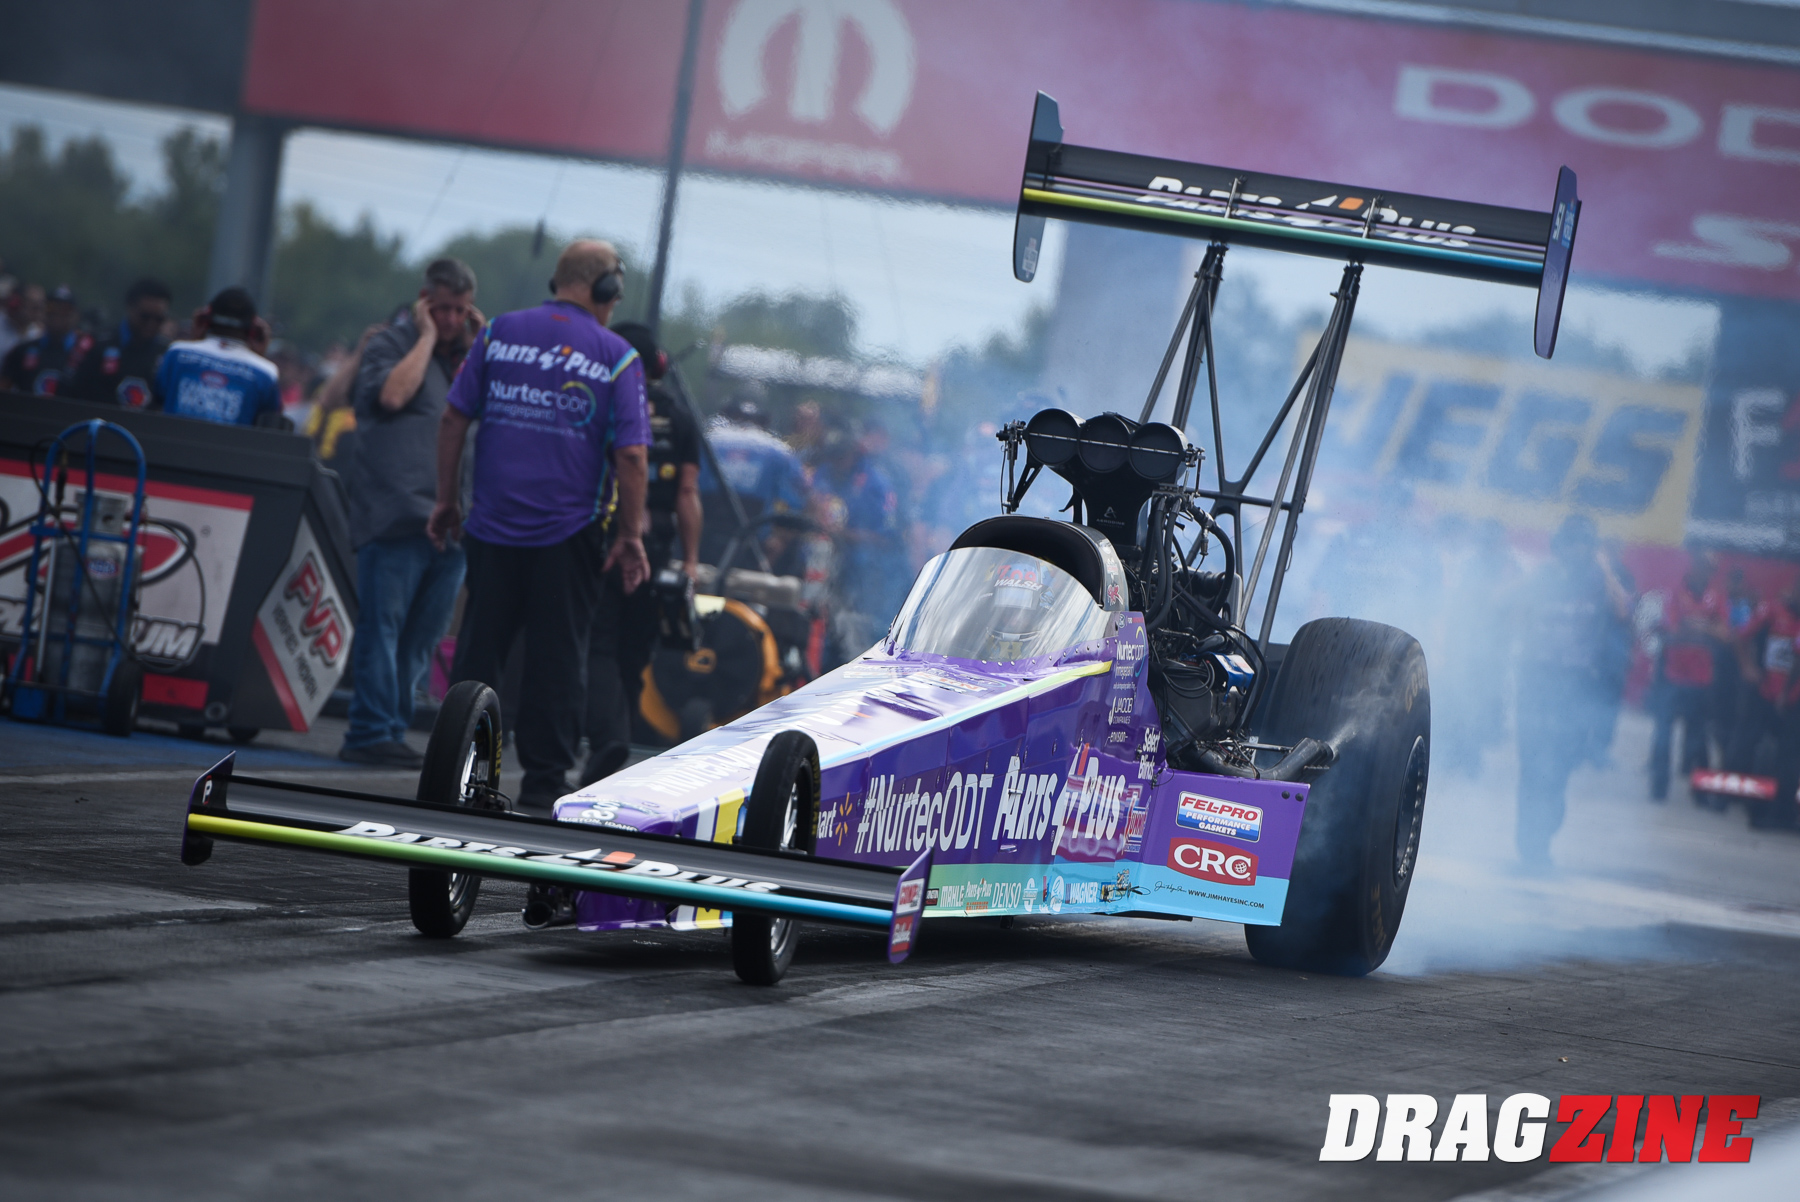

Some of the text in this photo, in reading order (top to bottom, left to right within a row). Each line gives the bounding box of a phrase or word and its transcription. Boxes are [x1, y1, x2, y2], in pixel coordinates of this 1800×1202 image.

[485, 340, 613, 383] PARTS PLUS
[993, 578, 1043, 592] WALSH
[1115, 697, 1134, 714] JACOB
[1142, 727, 1160, 754] Select
[854, 769, 994, 855] #NurtecODT
[1181, 796, 1259, 821] FEL-PRO
[1185, 811, 1251, 831] PERFORMANCE
[1198, 823, 1237, 836] GASKETS
[1173, 844, 1251, 880] CRC
[940, 885, 965, 908] MAHLE
[991, 882, 1022, 908] DENSO
[1070, 881, 1099, 904] WAGNER
[1187, 888, 1265, 909] WWW.JIMHAYESINC.COM
